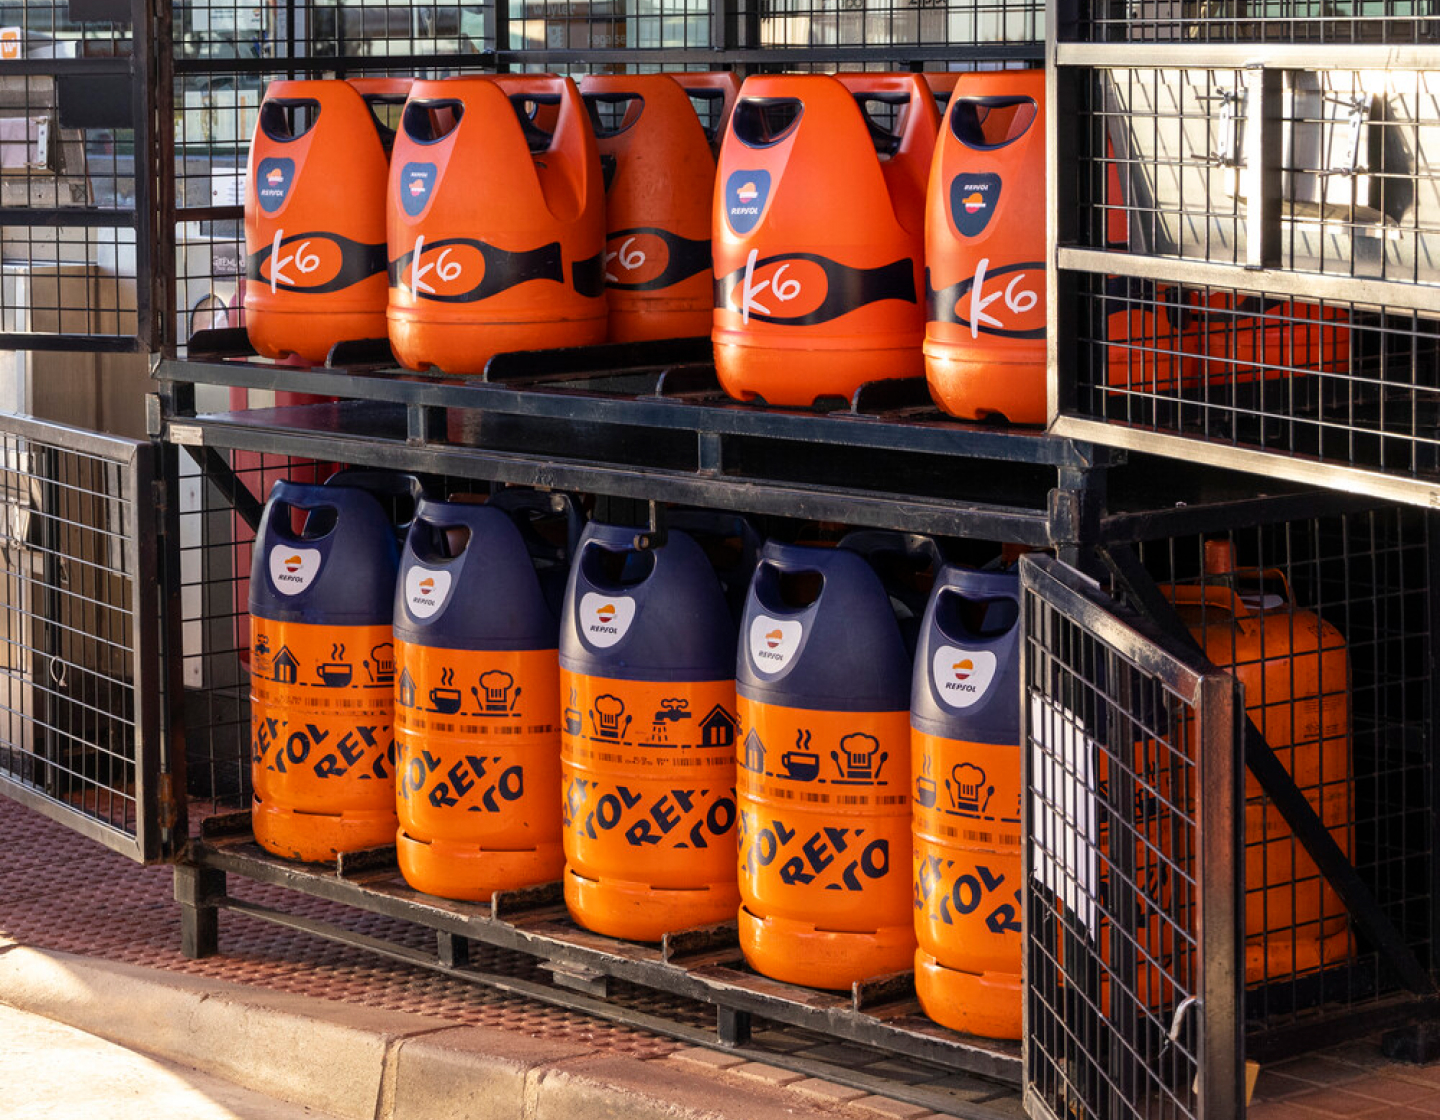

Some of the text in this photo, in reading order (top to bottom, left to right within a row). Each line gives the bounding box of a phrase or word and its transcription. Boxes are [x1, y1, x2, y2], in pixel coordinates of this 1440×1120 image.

[731, 207, 759, 215] REPSOL
[278, 573, 304, 584] REPSOL
[412, 596, 436, 607] REPSOL
[589, 624, 618, 635] REPSOL
[757, 651, 784, 661] REPSOL
[945, 681, 976, 693] REPSOL
